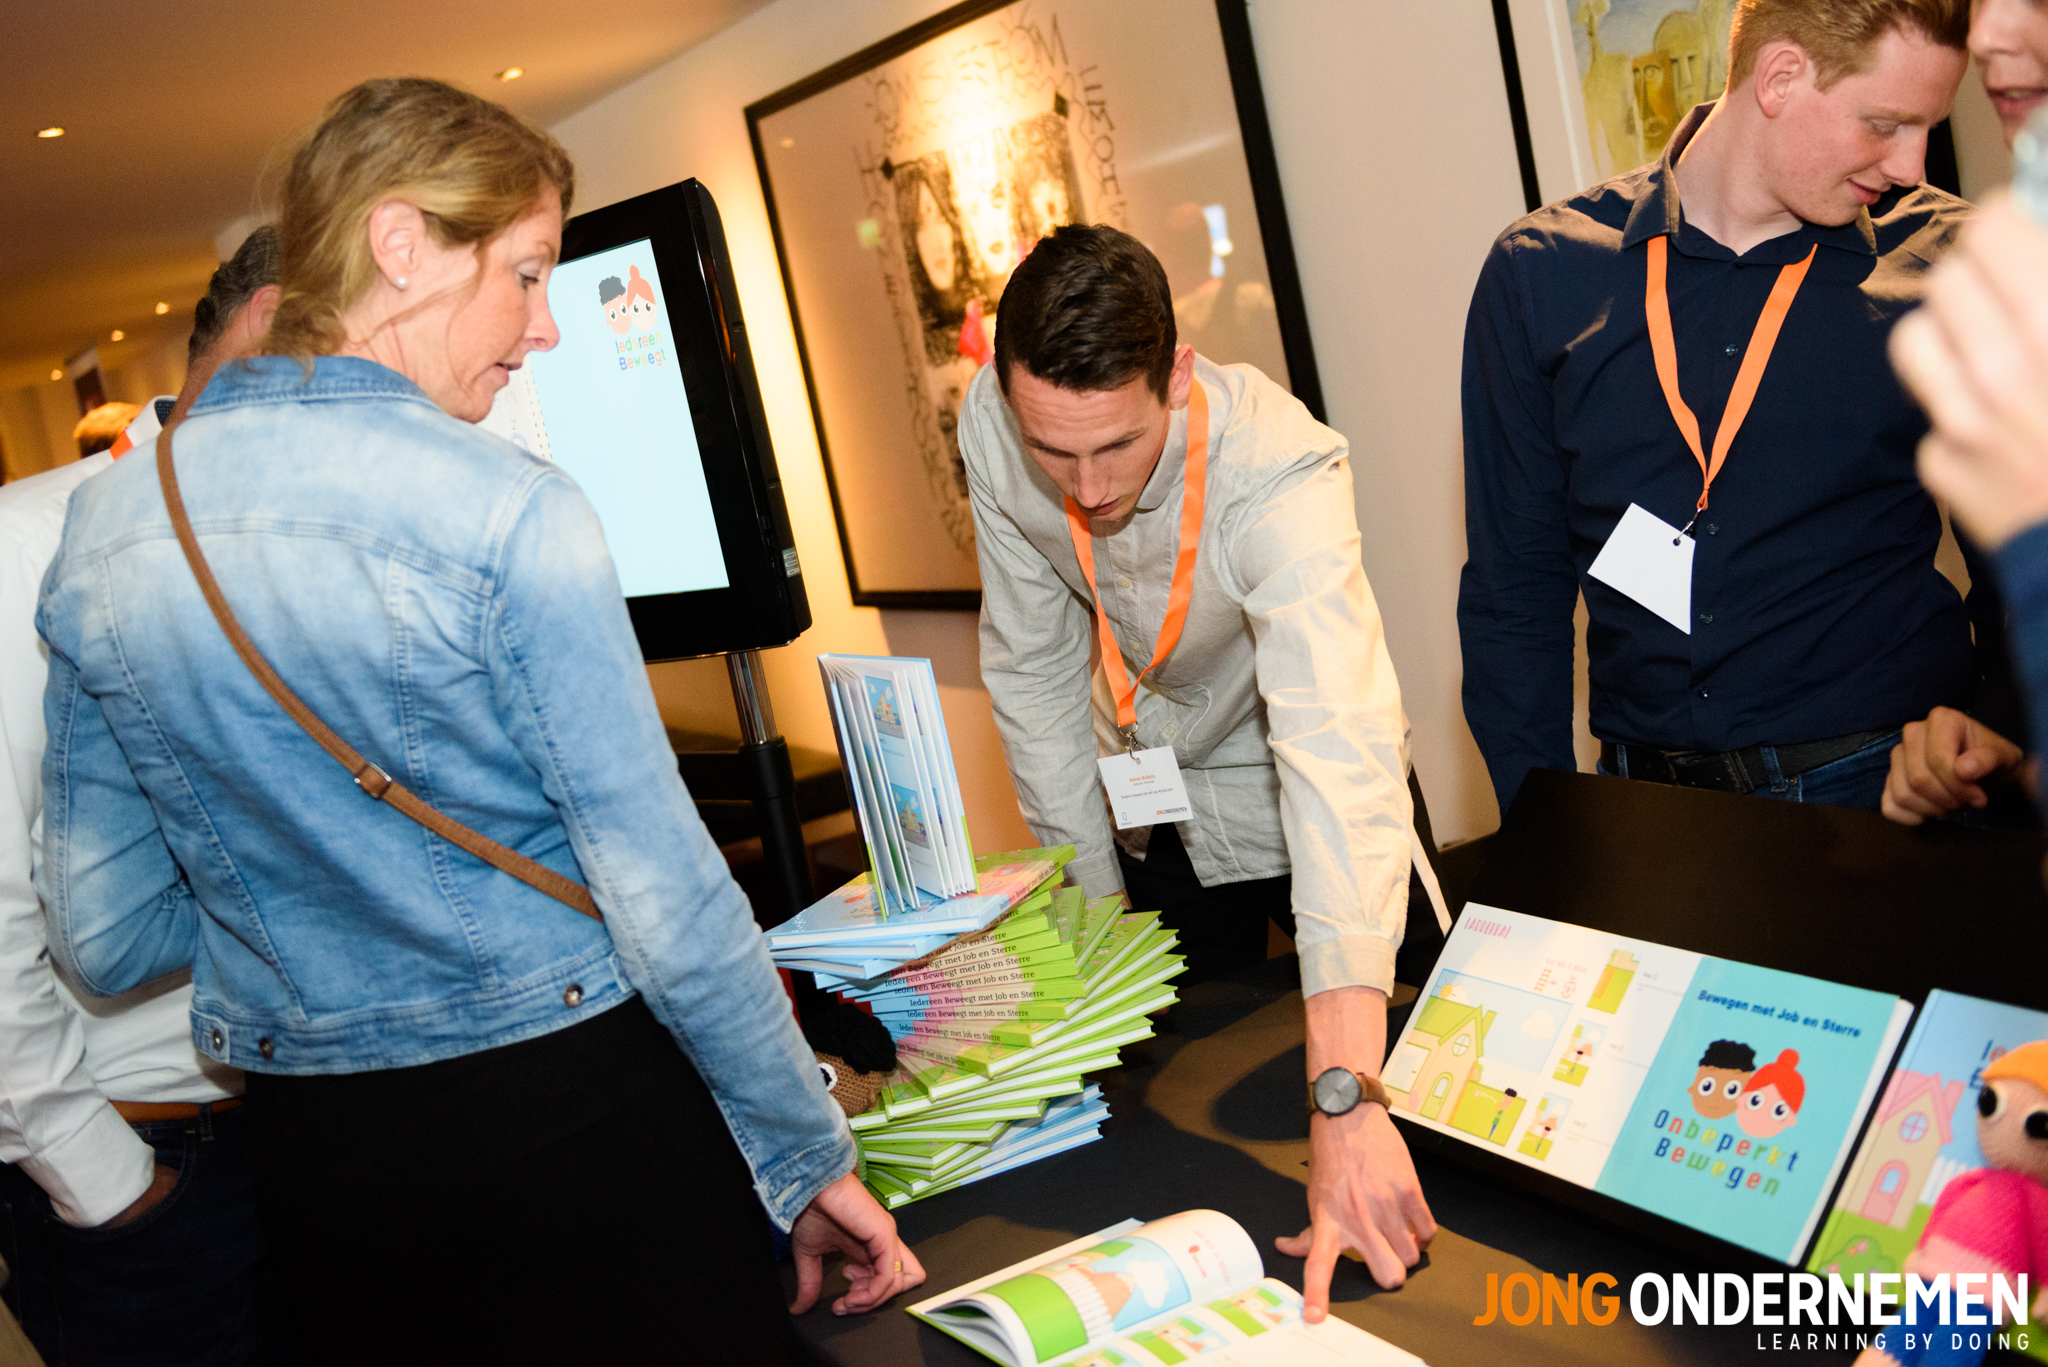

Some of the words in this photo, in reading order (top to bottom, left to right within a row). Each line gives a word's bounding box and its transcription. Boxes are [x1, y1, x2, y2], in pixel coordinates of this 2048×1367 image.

[615, 332, 662, 353] Iedereen
[619, 347, 666, 371] Beweegt
[954, 941, 967, 951] Job
[969, 938, 979, 946] en
[982, 931, 1007, 943] Sterre
[907, 959, 942, 972] Beweegt
[945, 955, 961, 964] met
[963, 951, 977, 963] Job
[991, 944, 1017, 954] Sterre
[885, 975, 921, 987] Iedereen
[923, 968, 957, 980] Beweegt
[959, 964, 976, 974] met
[978, 960, 991, 971] Job
[1005, 955, 1031, 965] Sterre
[895, 984, 929, 995] Iedereen
[931, 978, 964, 990] Beweegt
[966, 978, 981, 986] met
[983, 975, 997, 984] Job
[1010, 971, 1035, 980] Sterre
[910, 998, 943, 1006] Iedereen
[944, 995, 976, 1004] Beweegt
[995, 992, 1007, 1002] Job
[1021, 990, 1045, 998] Sterre
[938, 1010, 967, 1019] Beweegt
[984, 1009, 995, 1018] Job
[1008, 1009, 1029, 1017] Sterre
[1698, 989, 1749, 1010] Bewegen
[1751, 1003, 1775, 1017] met
[1777, 1008, 1799, 1023] Job
[1802, 1016, 1818, 1027] en
[1822, 1018, 1861, 1038] Sterre
[899, 1023, 924, 1033] Iedereen
[925, 1026, 949, 1038] Beweegt
[963, 1030, 973, 1039] Job
[974, 1032, 981, 1040] en
[982, 1032, 1001, 1042] Sterre
[1654, 1109, 1799, 1172] Onbeperkt
[1654, 1137, 1780, 1197] Bewegen
